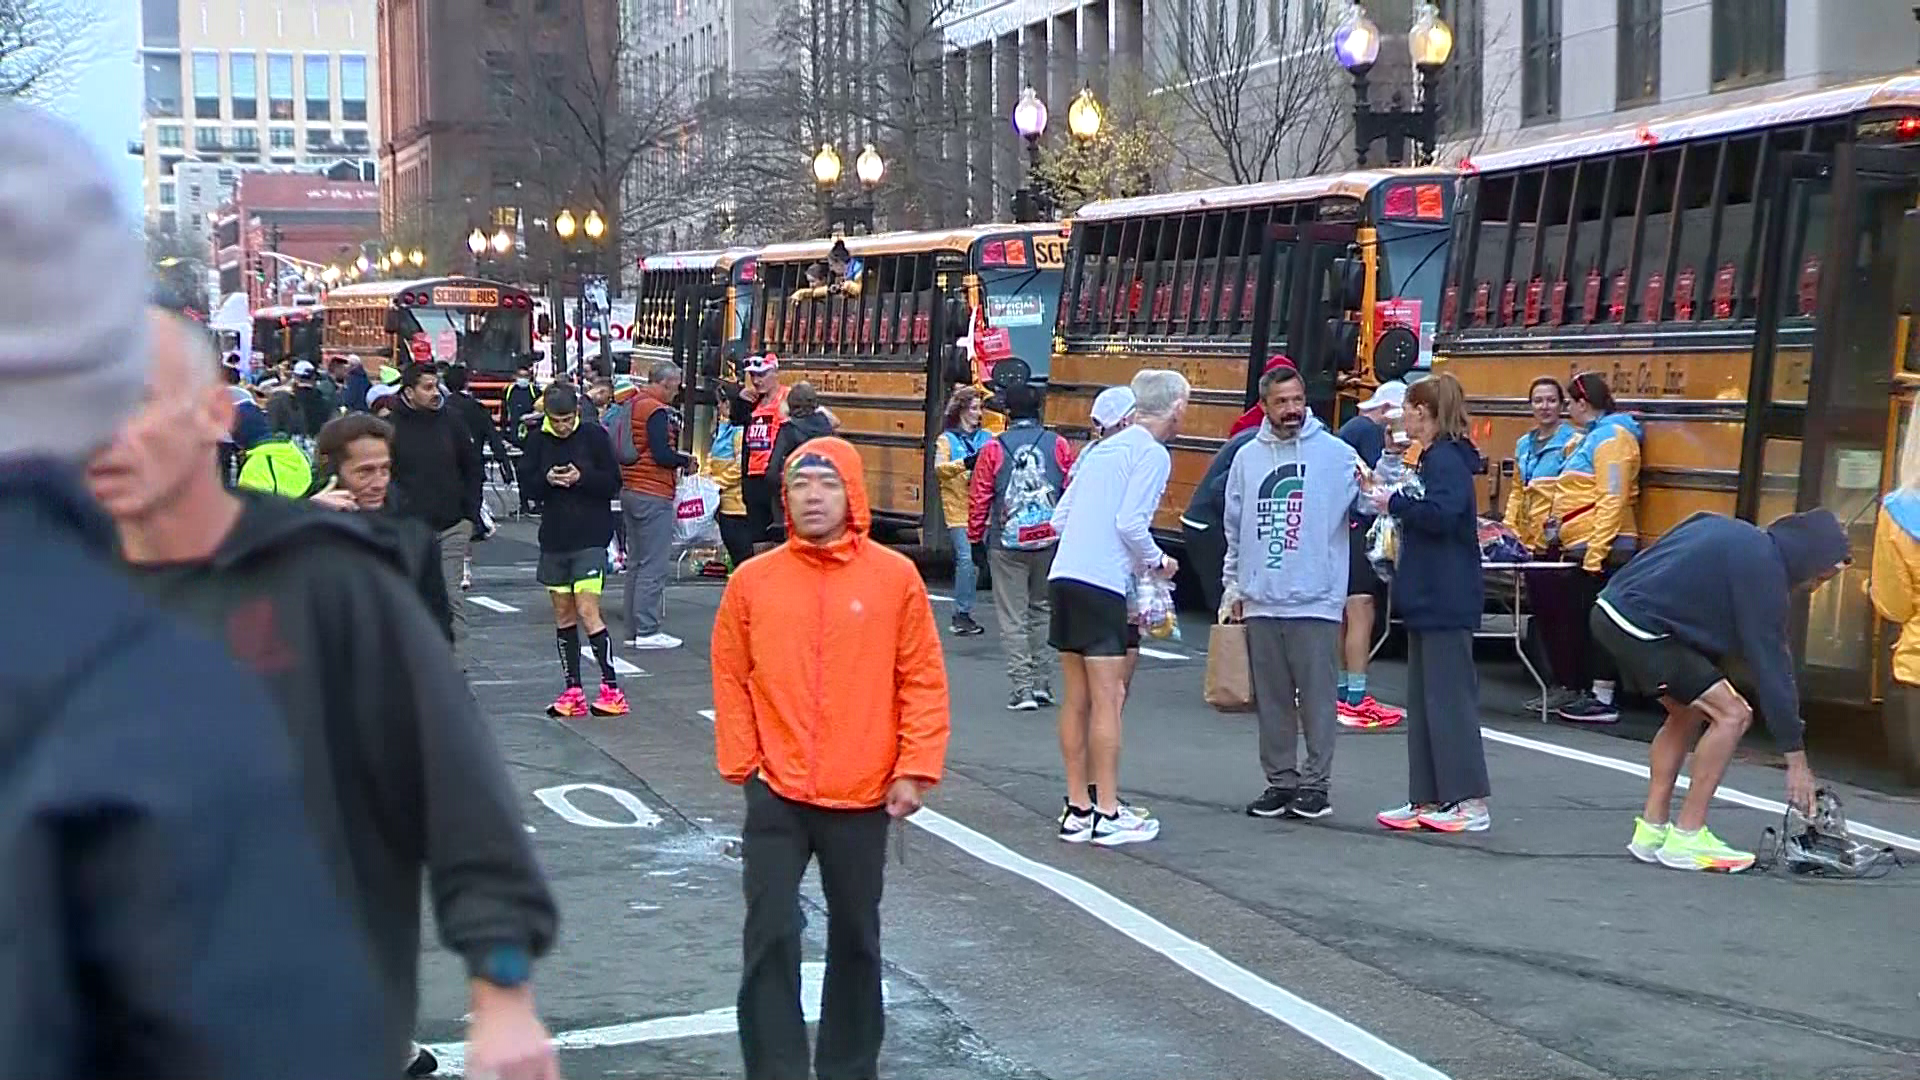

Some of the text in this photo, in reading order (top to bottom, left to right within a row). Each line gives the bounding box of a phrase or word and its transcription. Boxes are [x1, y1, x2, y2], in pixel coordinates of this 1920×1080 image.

[436, 289, 497, 304] SCHOOL BUS
[994, 301, 1035, 310] OFFICIAL
[1257, 501, 1271, 540] THE
[1266, 500, 1286, 569] NORTH
[1284, 501, 1302, 550] FACE
